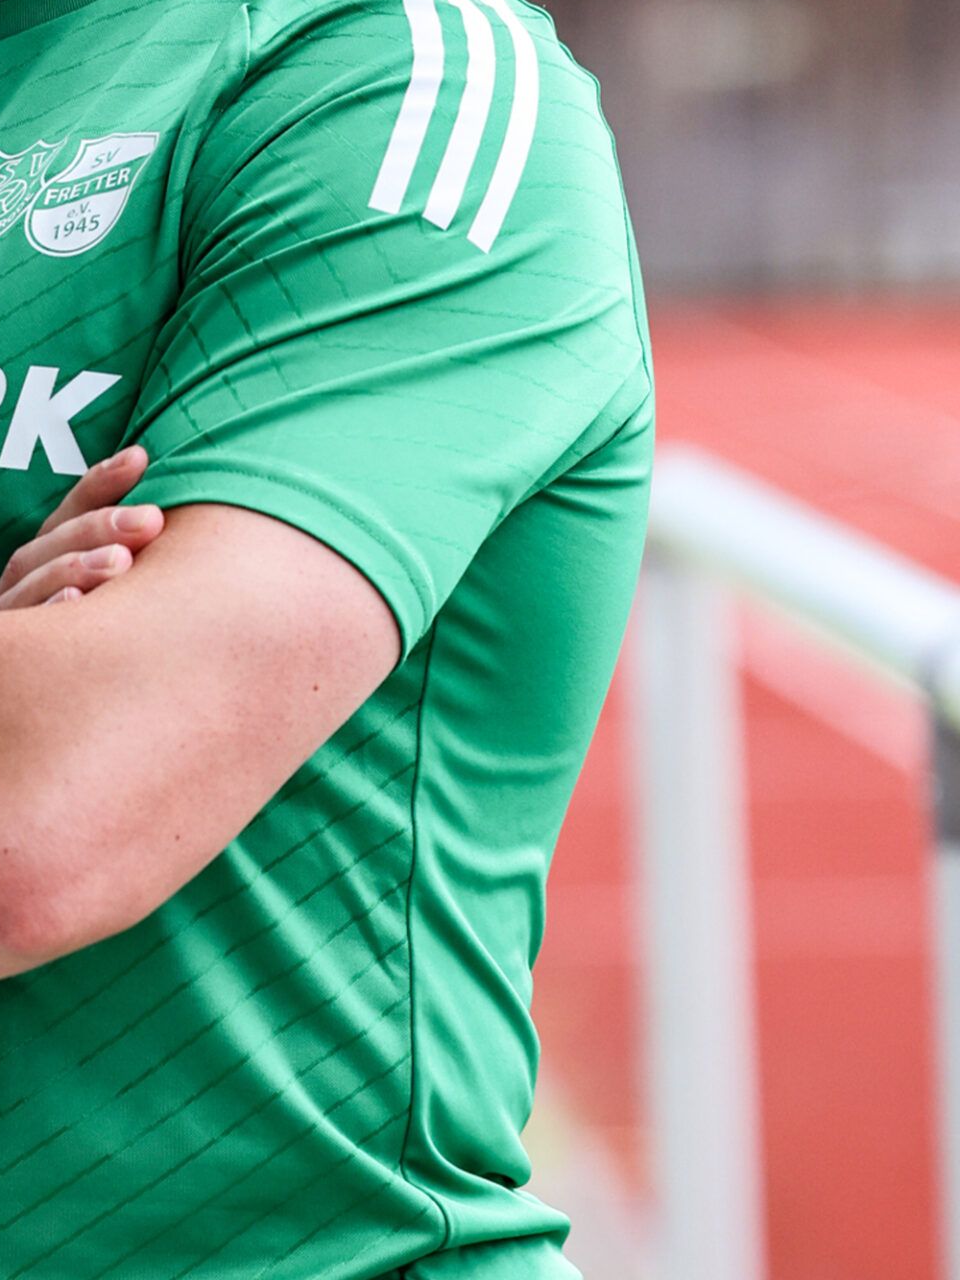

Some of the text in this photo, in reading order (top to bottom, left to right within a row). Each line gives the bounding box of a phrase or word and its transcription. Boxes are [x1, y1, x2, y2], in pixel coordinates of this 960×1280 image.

[91, 148, 120, 168] SV
[44, 168, 129, 205] FRETTER
[53, 214, 101, 241] 1945
